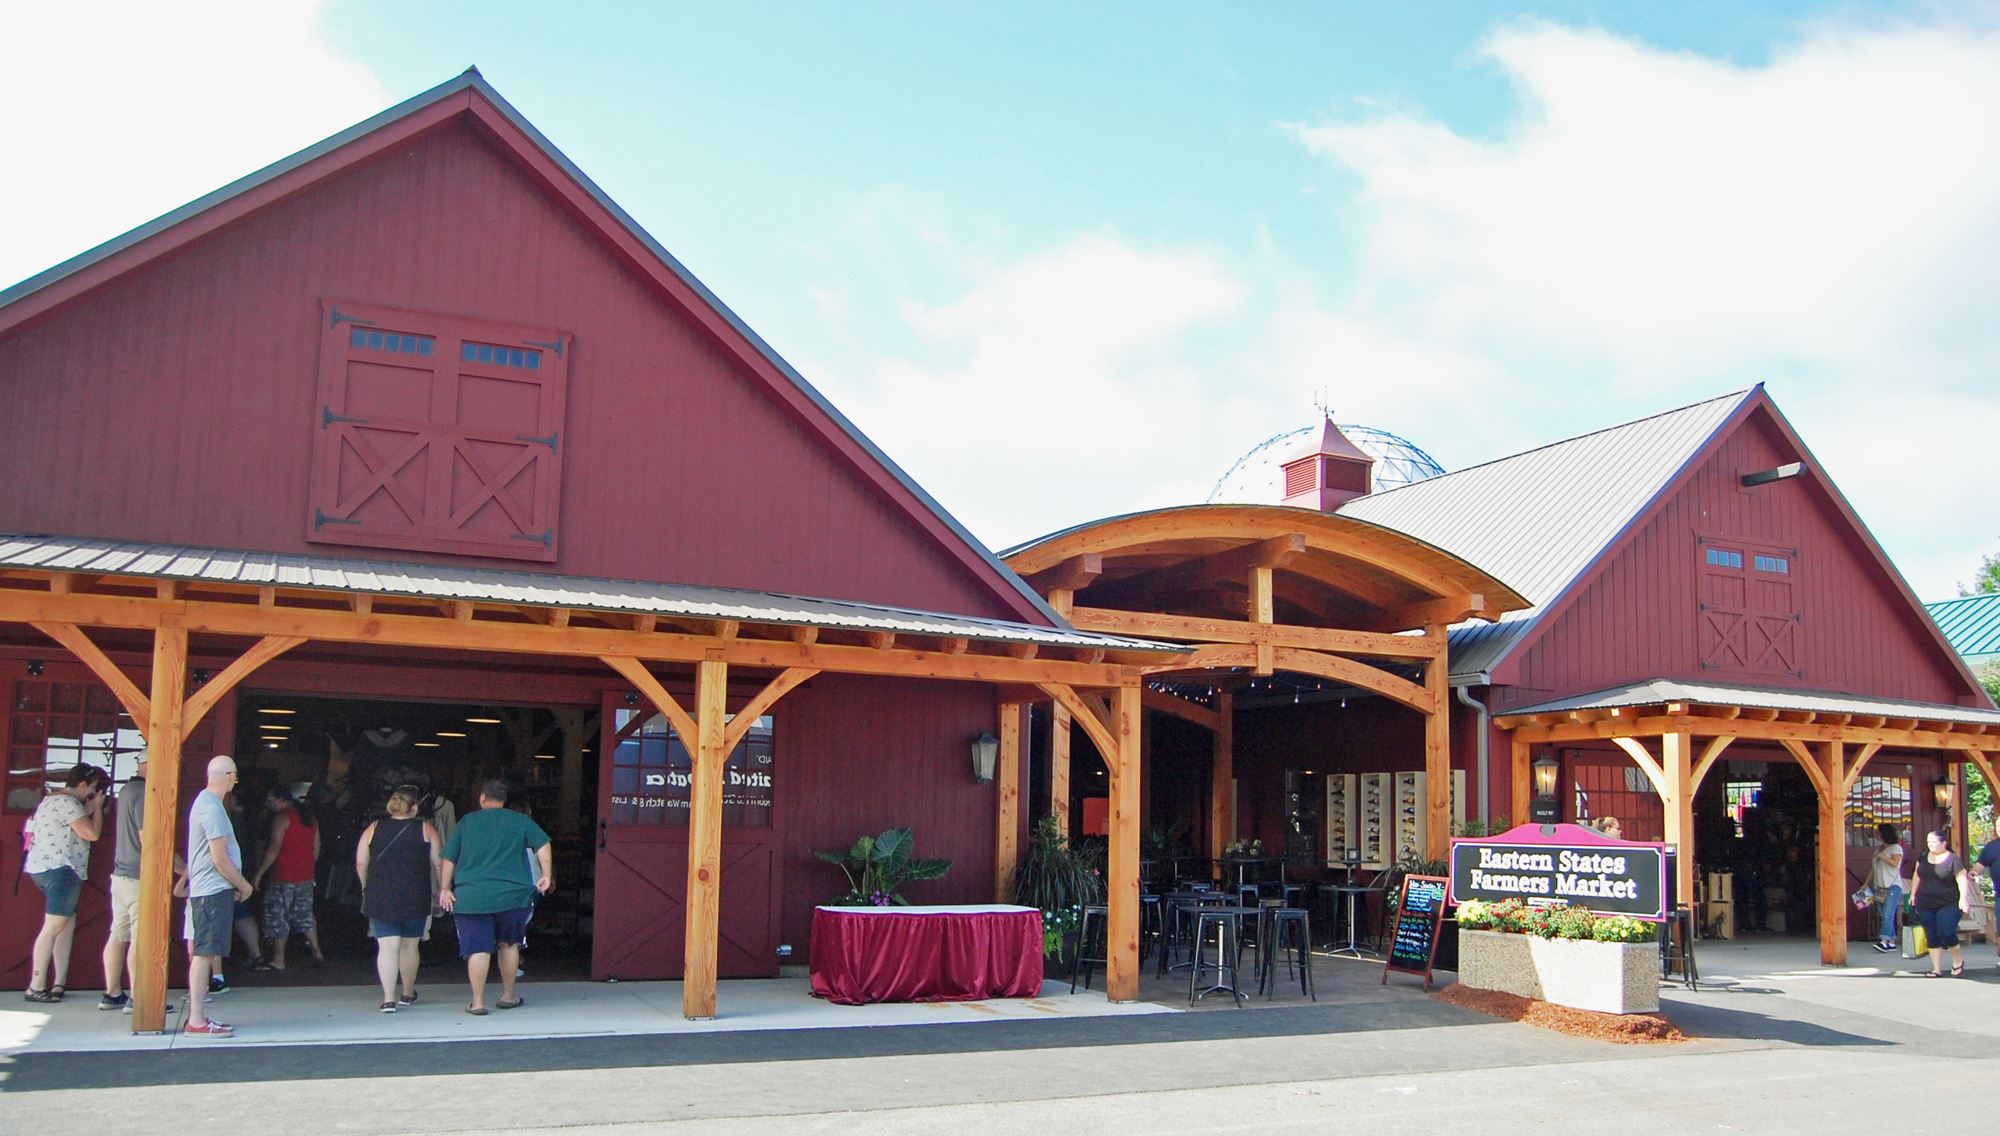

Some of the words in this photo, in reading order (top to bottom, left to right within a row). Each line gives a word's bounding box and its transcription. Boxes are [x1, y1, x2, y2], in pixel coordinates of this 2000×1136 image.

[1479, 848, 1554, 871] Eastern
[1559, 850, 1626, 874] States
[1470, 869, 1550, 894] Farmers
[1555, 873, 1638, 899] Market
